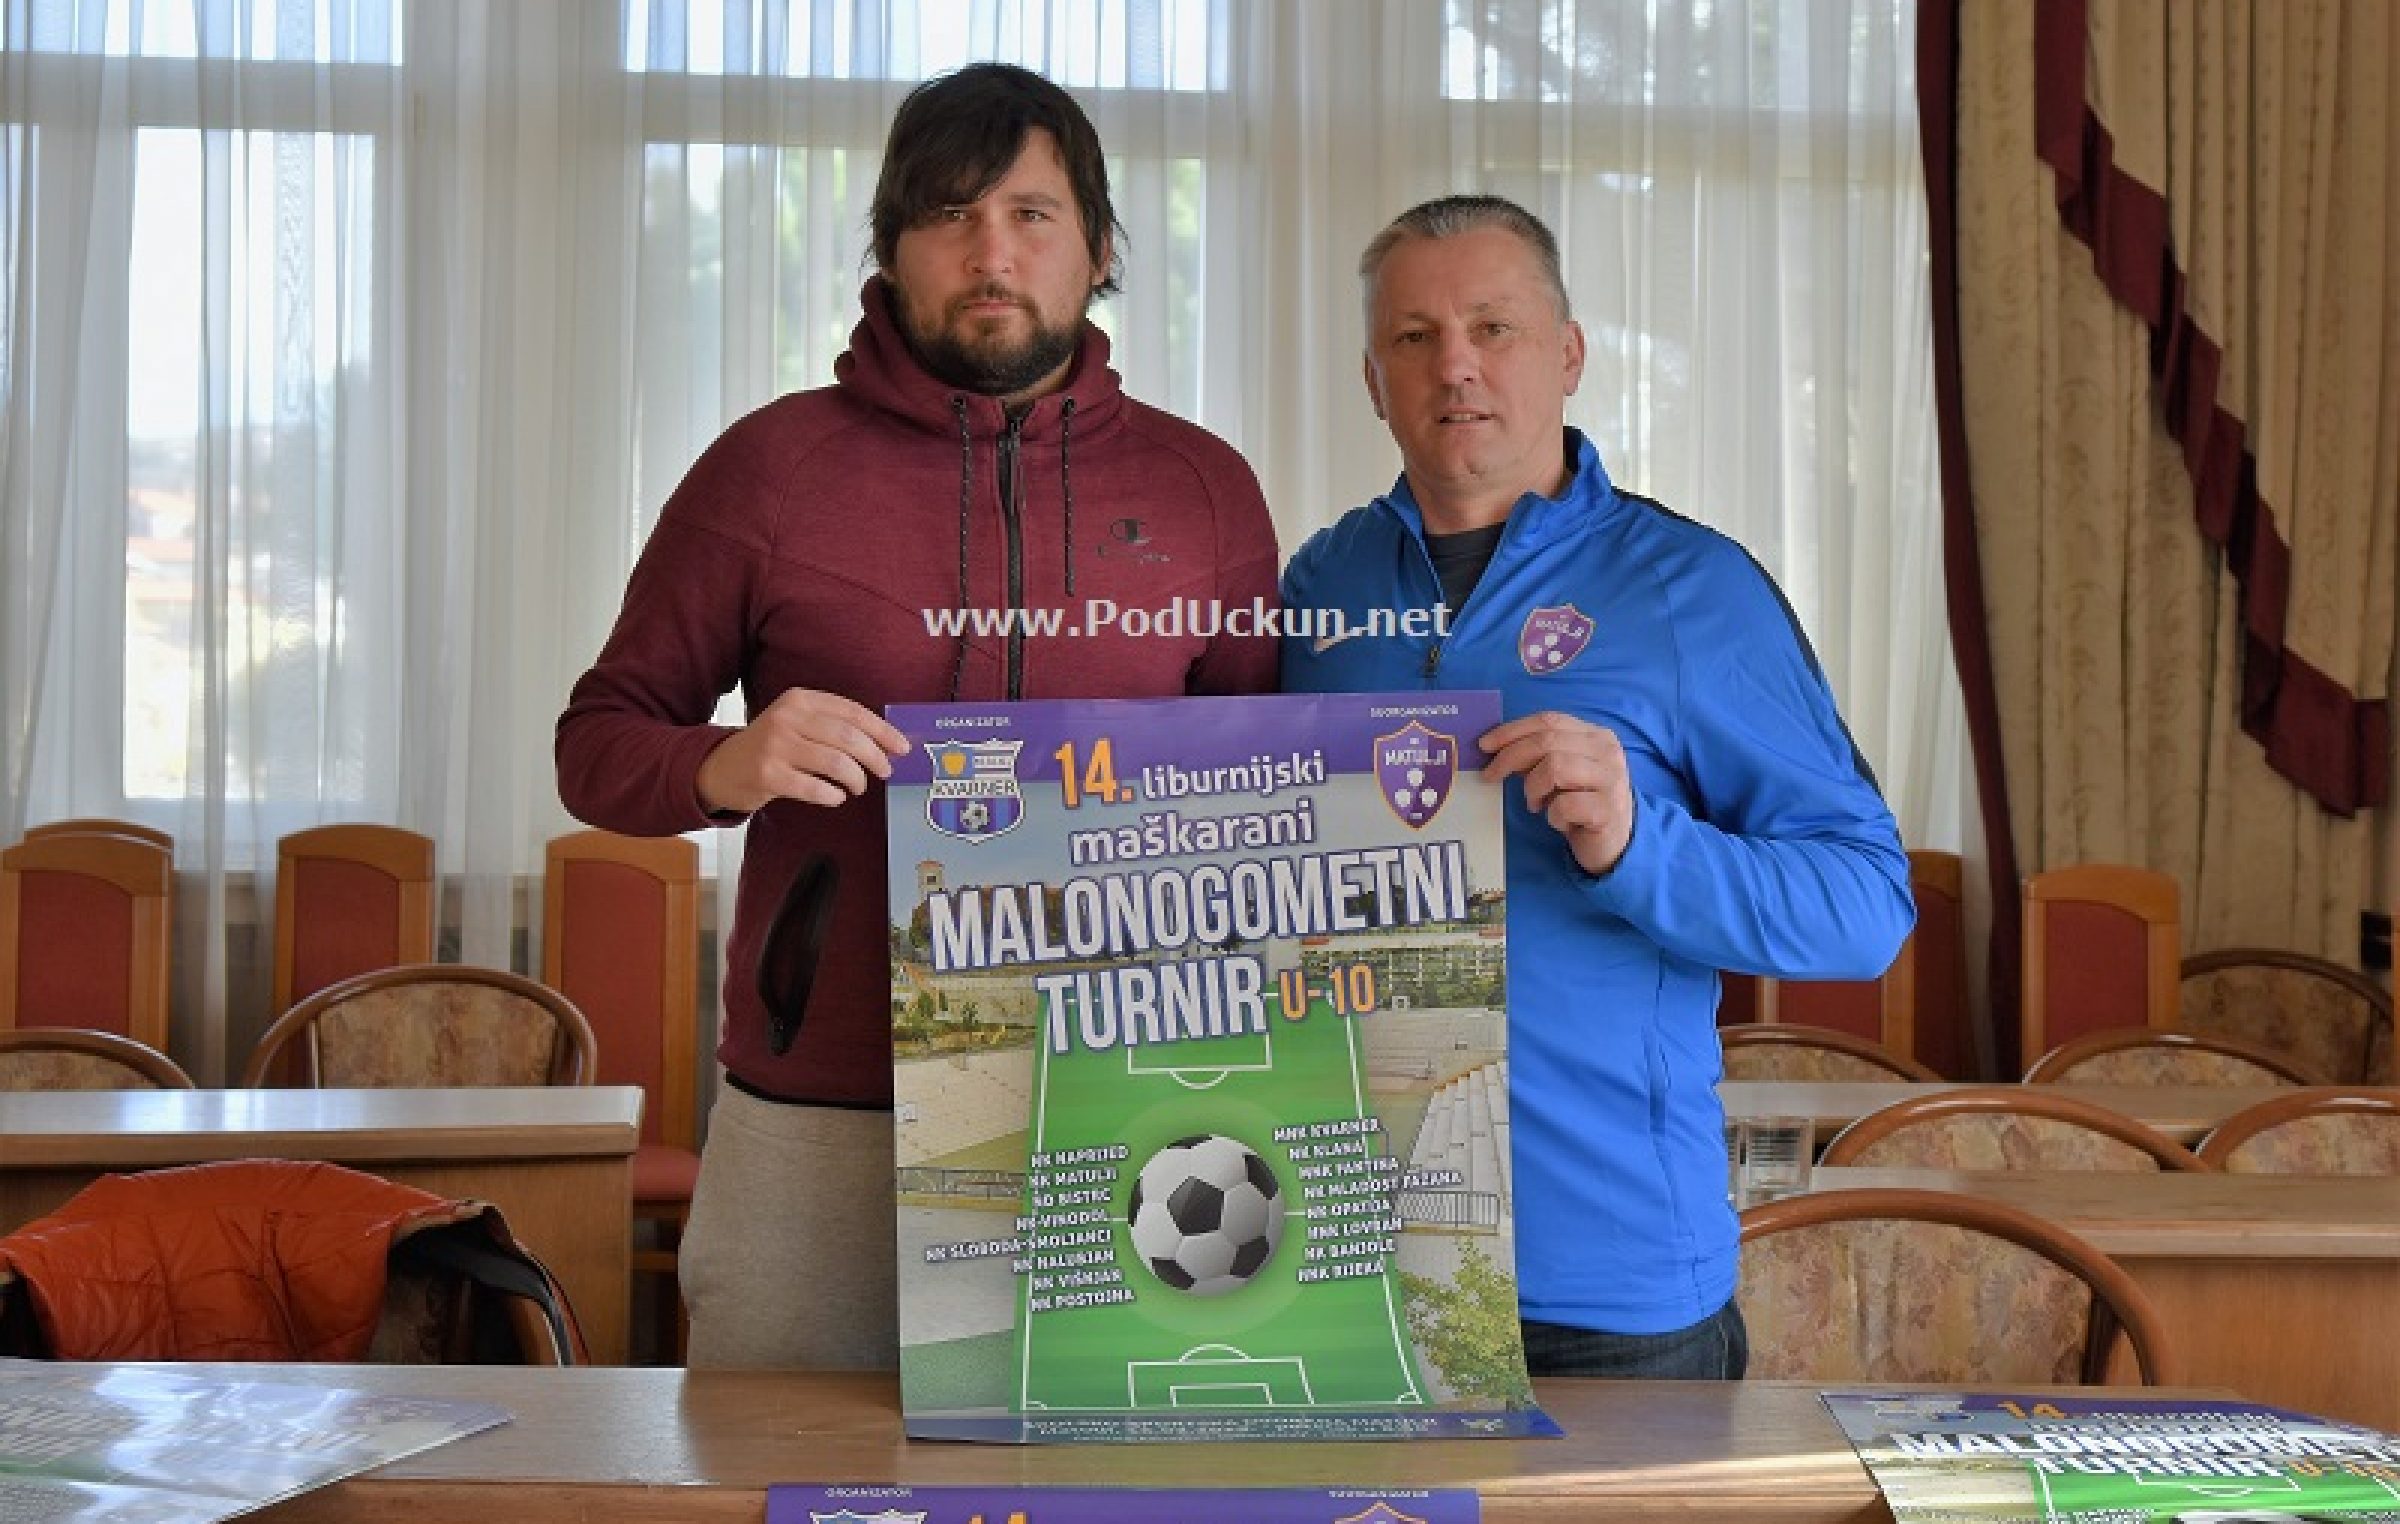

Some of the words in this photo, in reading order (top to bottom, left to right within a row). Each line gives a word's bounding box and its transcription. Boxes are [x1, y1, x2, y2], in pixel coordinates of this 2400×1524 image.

[1055, 738, 1134, 807] 14.
[1141, 749, 1325, 799] liburnijski
[1072, 800, 1313, 866] maškarani
[929, 842, 1466, 970] MALONOGOMETNI
[1037, 957, 1268, 1053] TURNIR
[1311, 1118, 1380, 1137] KVARNER
